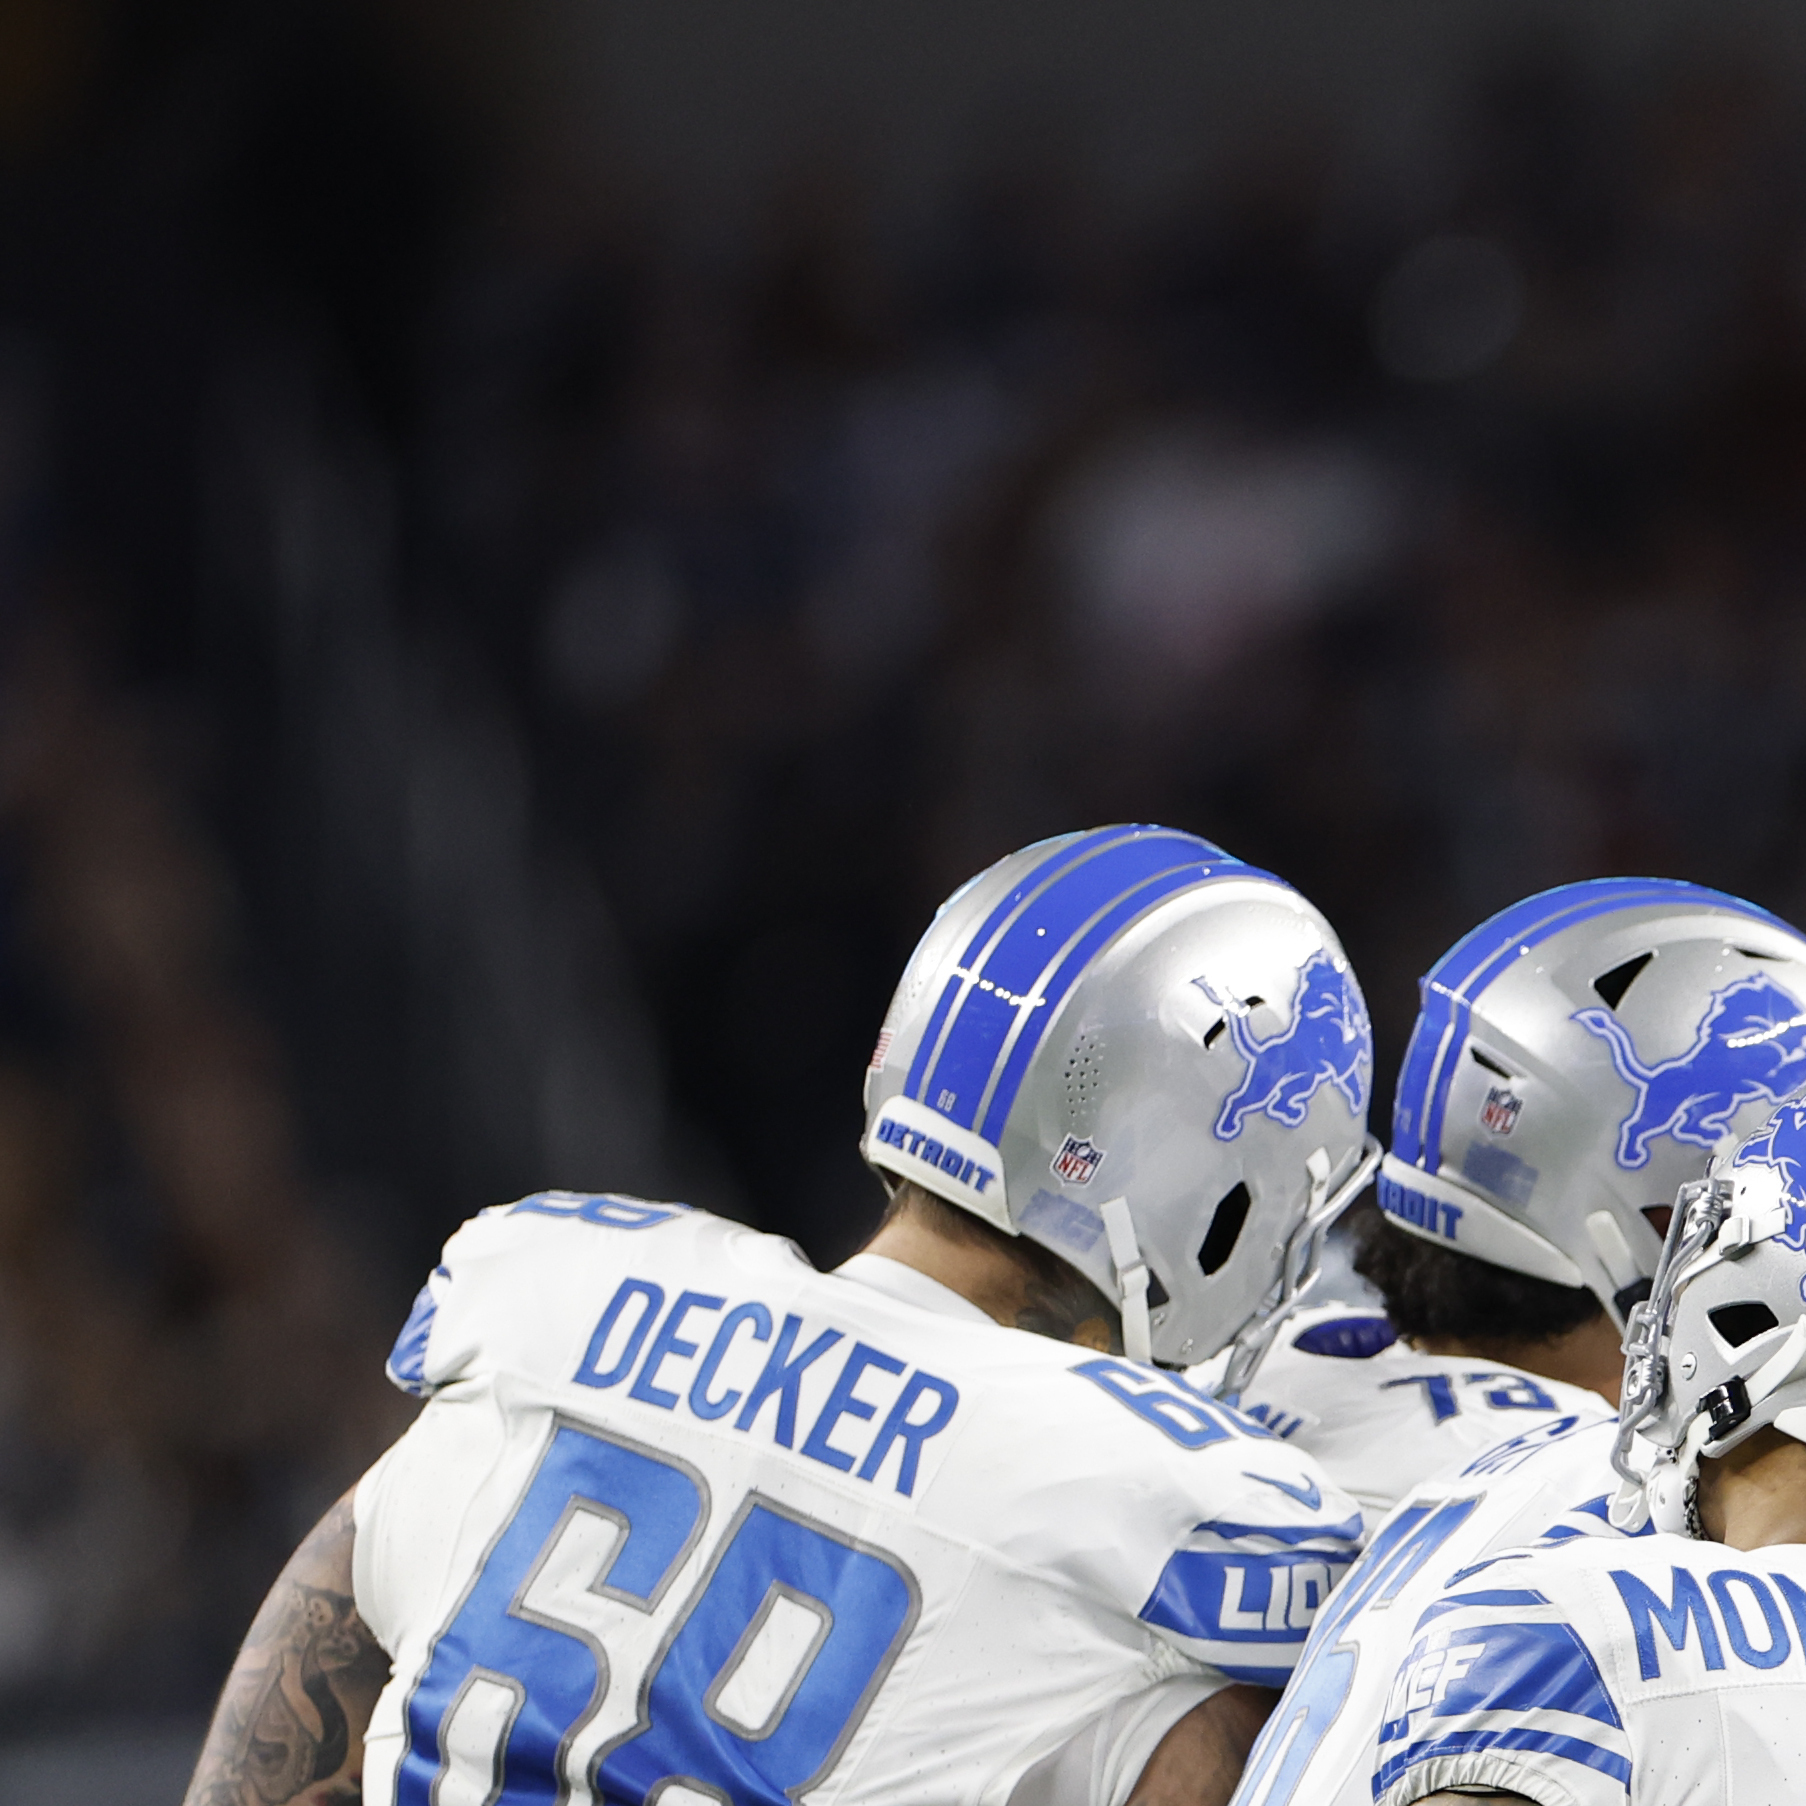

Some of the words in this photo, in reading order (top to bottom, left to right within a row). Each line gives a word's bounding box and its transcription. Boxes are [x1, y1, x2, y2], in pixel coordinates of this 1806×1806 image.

[937, 1088, 957, 1112] 68
[1481, 1101, 1514, 1135] NFL
[876, 1116, 997, 1195] DETROIT
[1058, 1151, 1091, 1183] NFL
[1377, 1169, 1464, 1240] ROIT
[571, 1276, 960, 1499] DECKER
[1218, 1561, 1352, 1632] LIO
